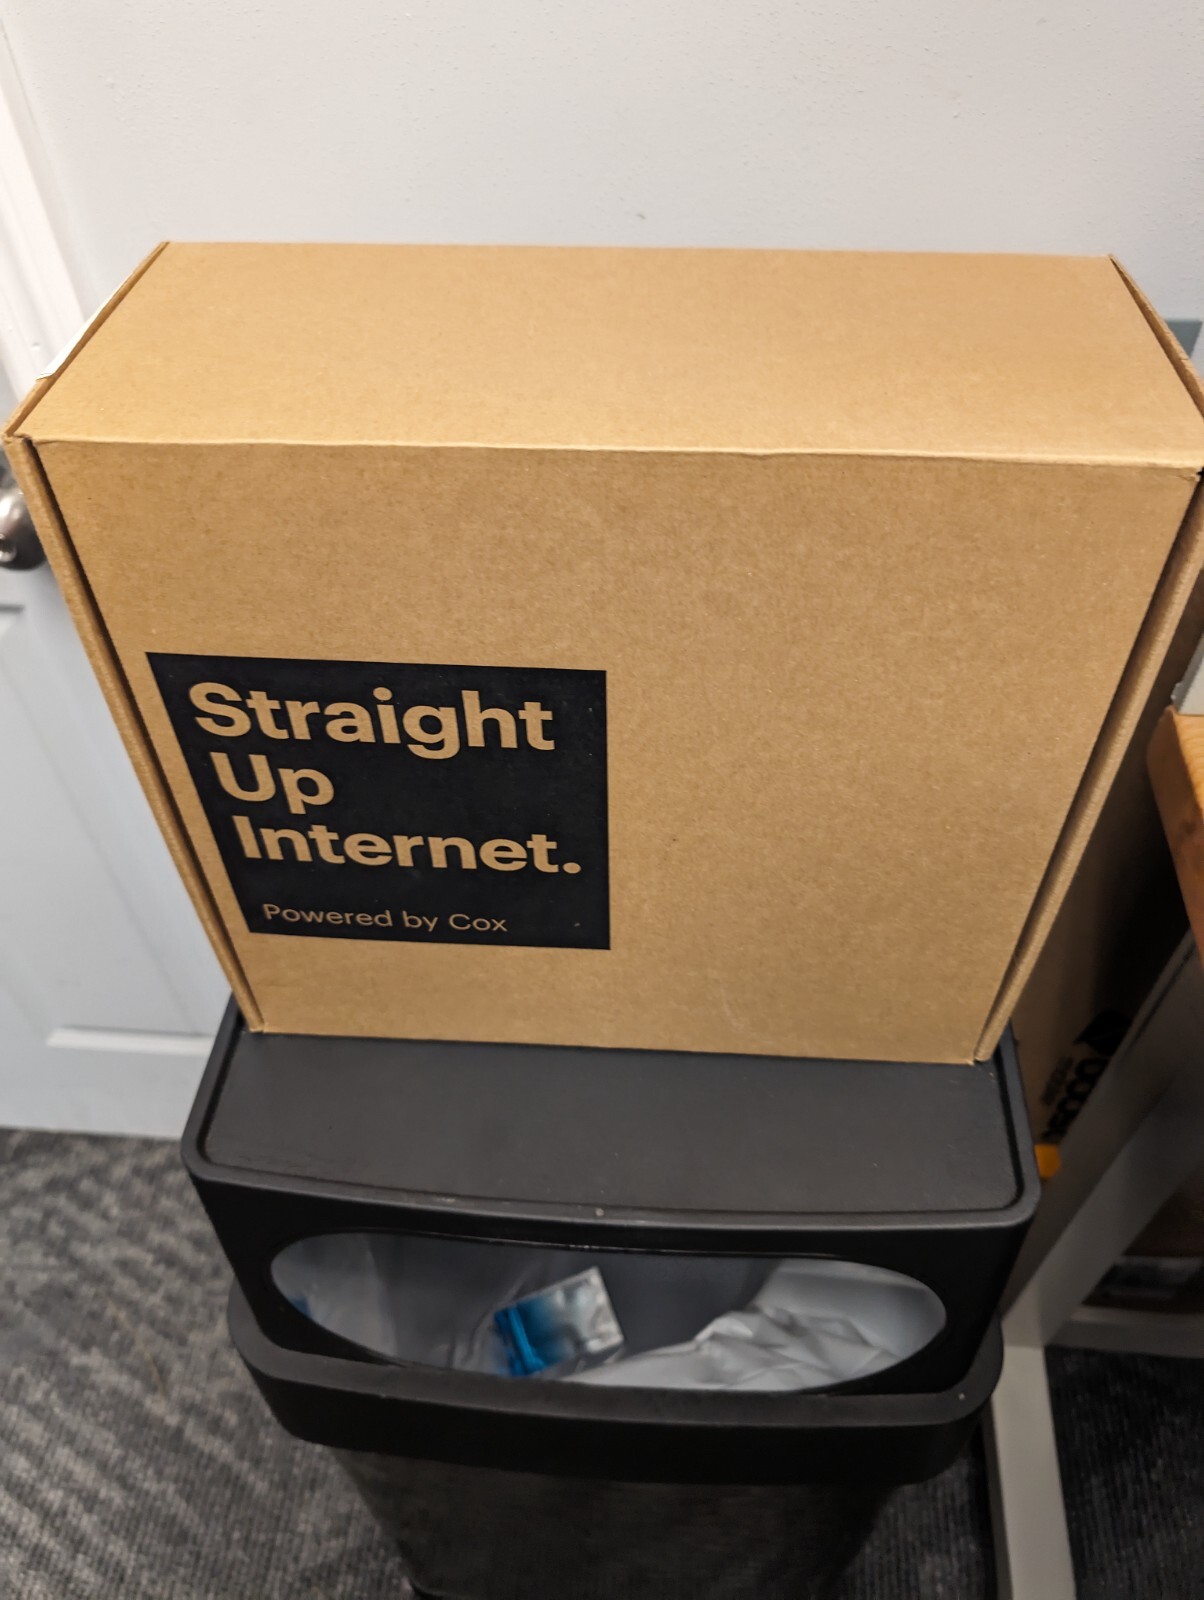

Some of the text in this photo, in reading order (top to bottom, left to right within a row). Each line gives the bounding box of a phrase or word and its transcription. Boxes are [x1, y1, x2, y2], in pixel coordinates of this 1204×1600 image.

[189, 681, 555, 759] Straight
[209, 751, 334, 815] Up
[231, 815, 581, 874] Internet.
[263, 903, 508, 932] Powered by Cox
